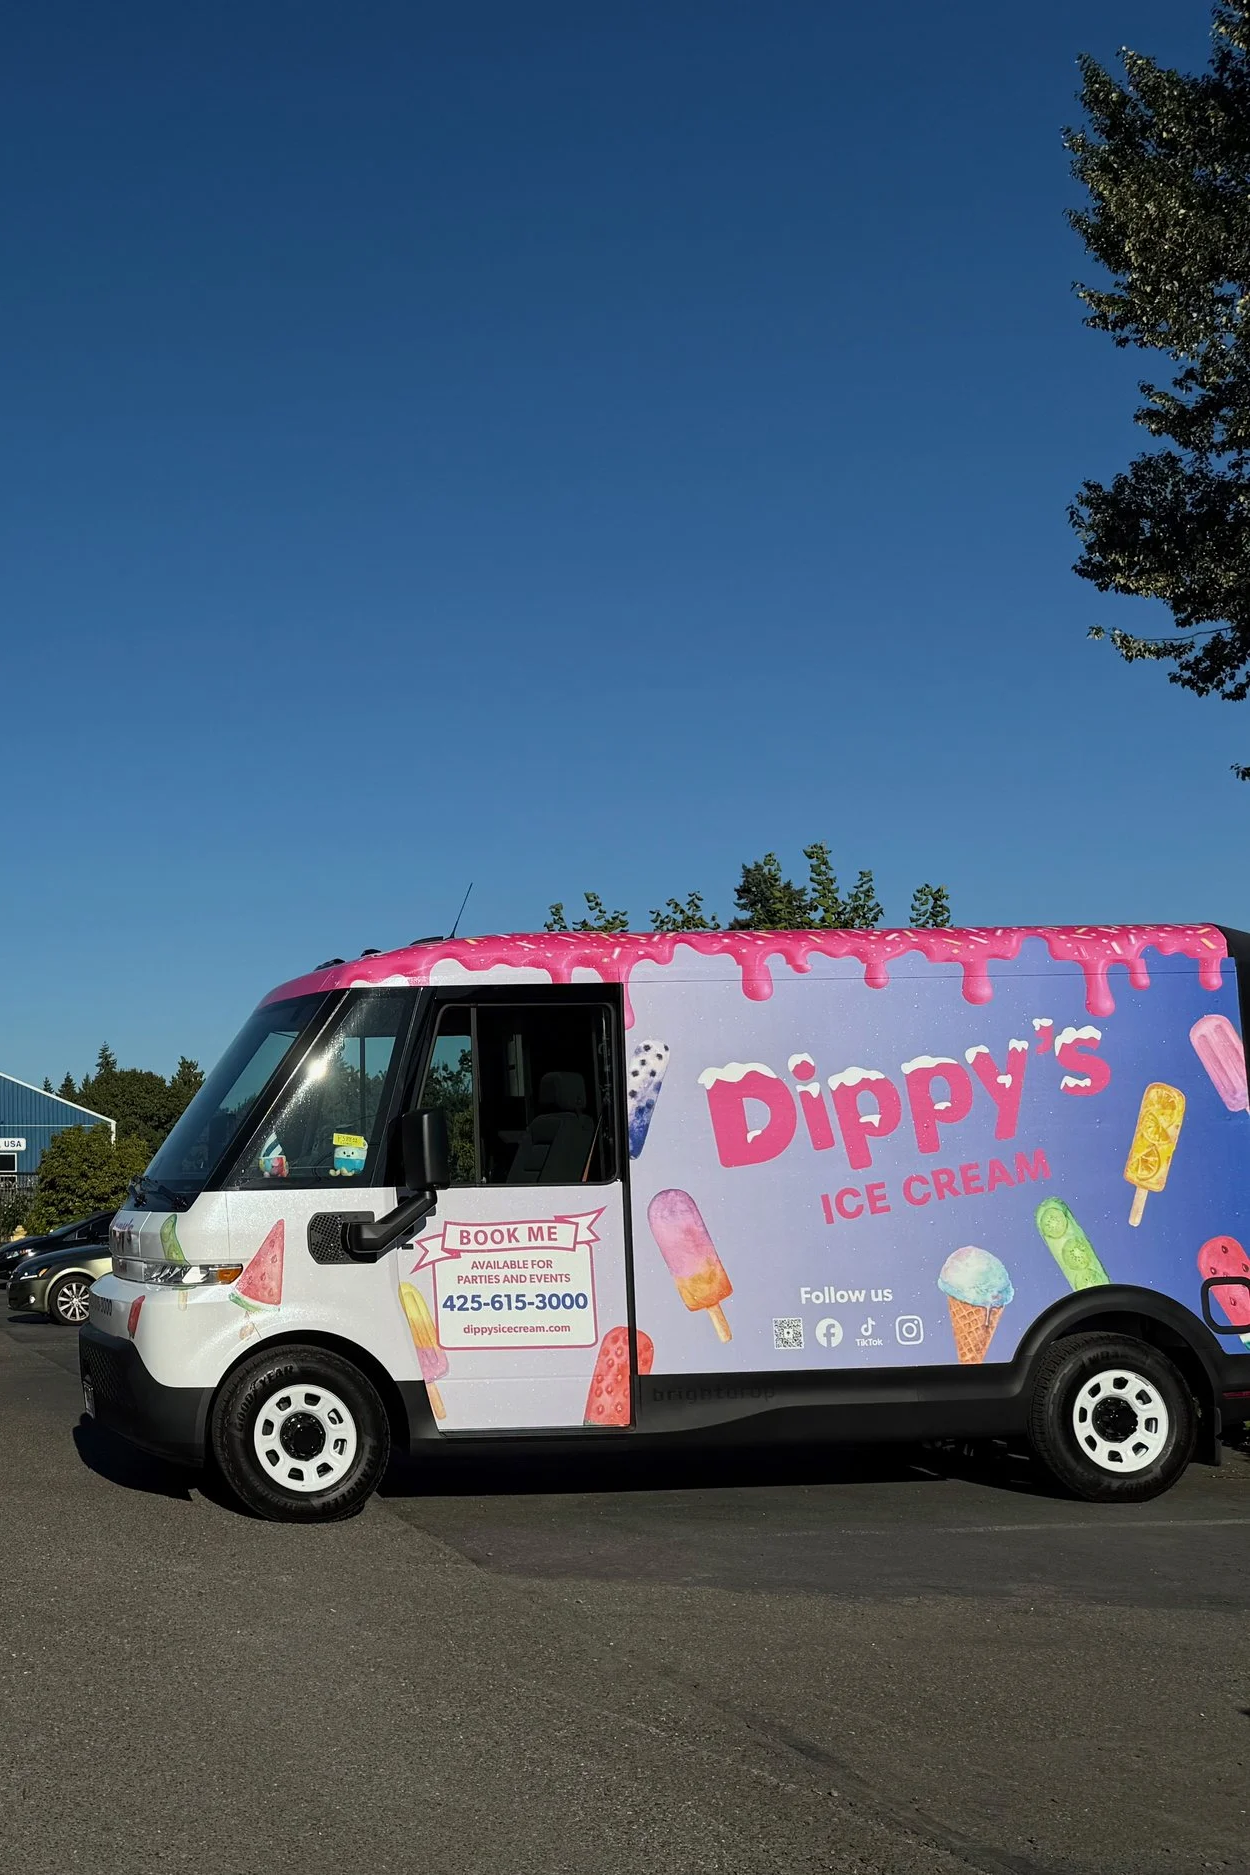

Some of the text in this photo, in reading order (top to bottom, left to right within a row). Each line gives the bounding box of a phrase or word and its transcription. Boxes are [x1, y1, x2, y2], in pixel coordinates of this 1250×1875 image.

[698, 1017, 1112, 1170] Dippy's
[4, 1140, 22, 1148] USA
[821, 1147, 1052, 1225] ICE CREAM
[459, 1225, 558, 1246] BOOK ME
[470, 1259, 553, 1270] AVAILABLE FOR
[457, 1273, 571, 1284] PARTIES AND EVENTS
[442, 1292, 588, 1312] 425-615-3000
[800, 1286, 893, 1304] Follow us
[463, 1324, 571, 1337] dippysicecream.com
[855, 1338, 883, 1347] TikTok
